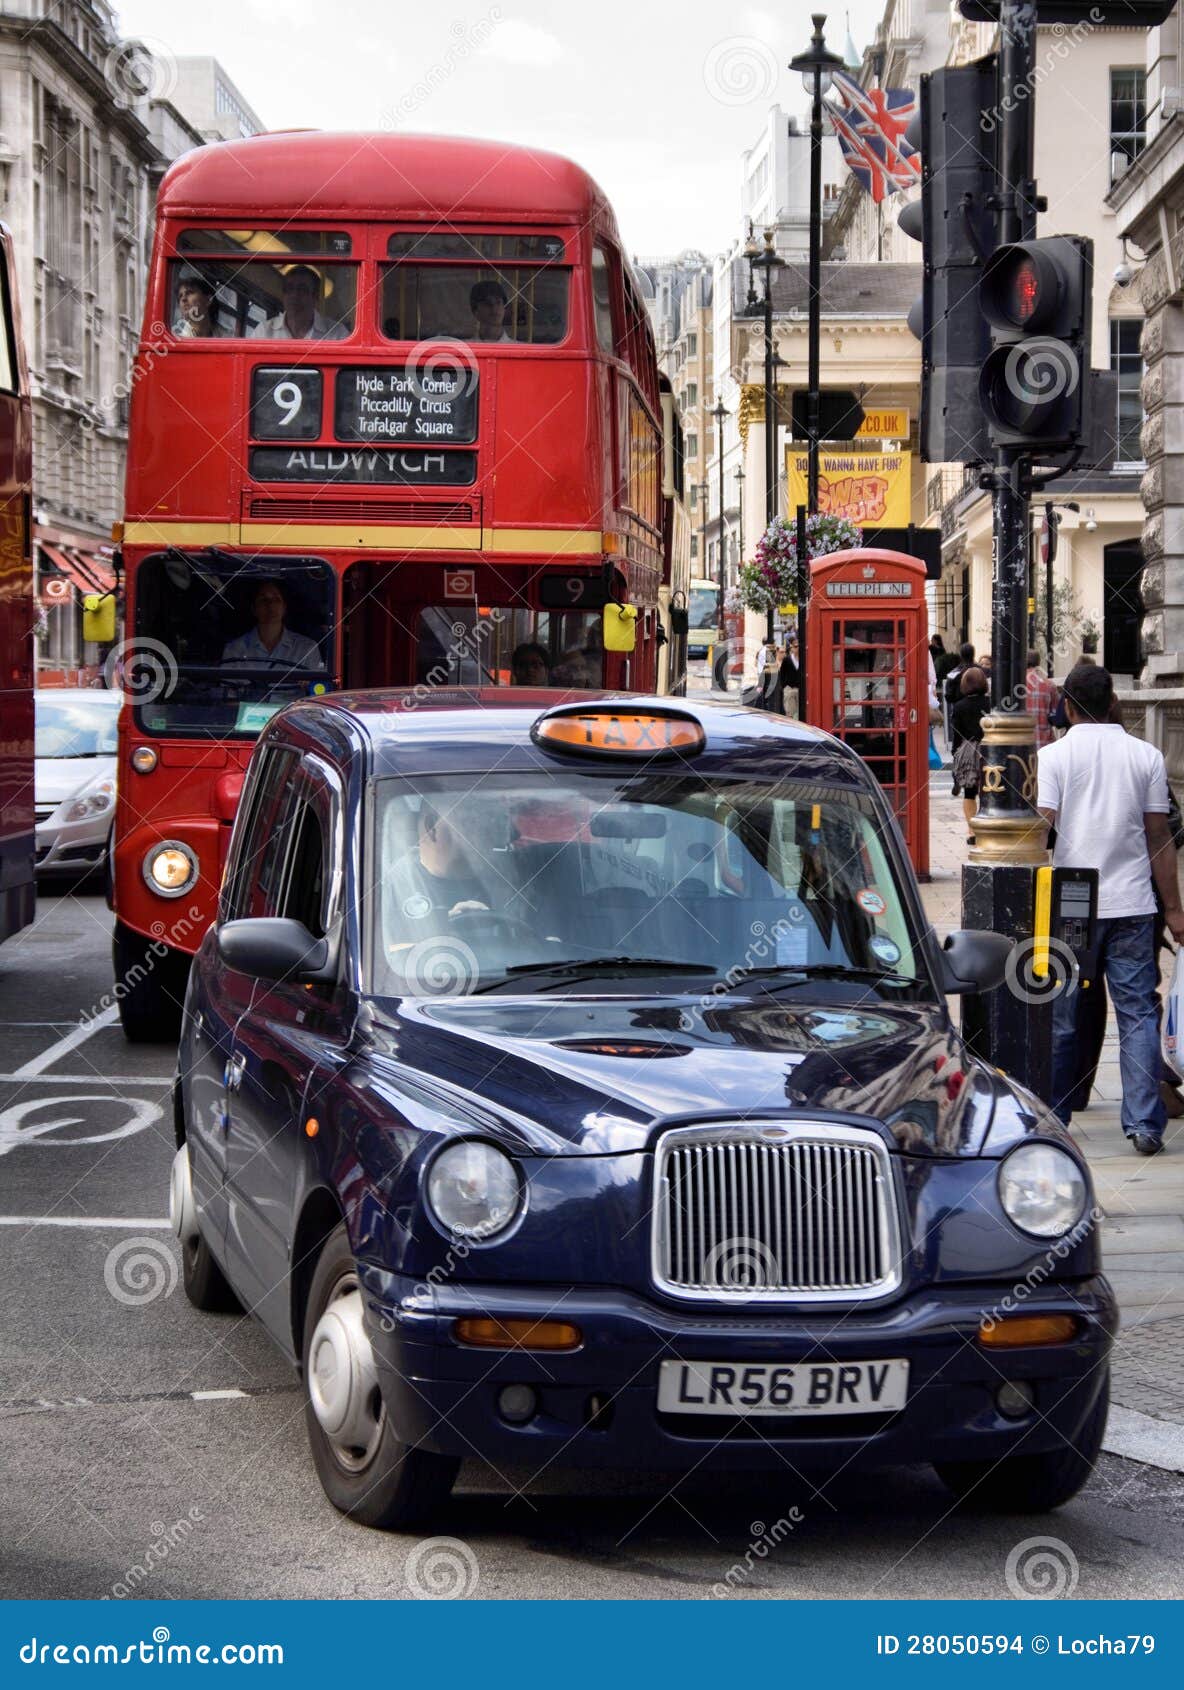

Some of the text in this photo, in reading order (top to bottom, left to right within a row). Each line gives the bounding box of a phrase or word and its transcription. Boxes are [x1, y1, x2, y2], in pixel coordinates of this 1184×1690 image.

[356, 376, 457, 395] Hyde Park Corner
[273, 381, 302, 426] 9
[361, 397, 451, 416] Piccadilly Circus
[359, 417, 453, 437] Trafalgar Square
[860, 415, 898, 432] .CO.UK
[286, 452, 445, 472] ALDWYCH
[824, 457, 855, 472] WANNA
[857, 457, 880, 472] HAVE
[882, 456, 903, 471] FUN?
[818, 475, 889, 506] SWEET
[566, 578, 585, 603] 9
[578, 716, 672, 746] TAXI
[678, 1364, 890, 1405] LR56 BRV
